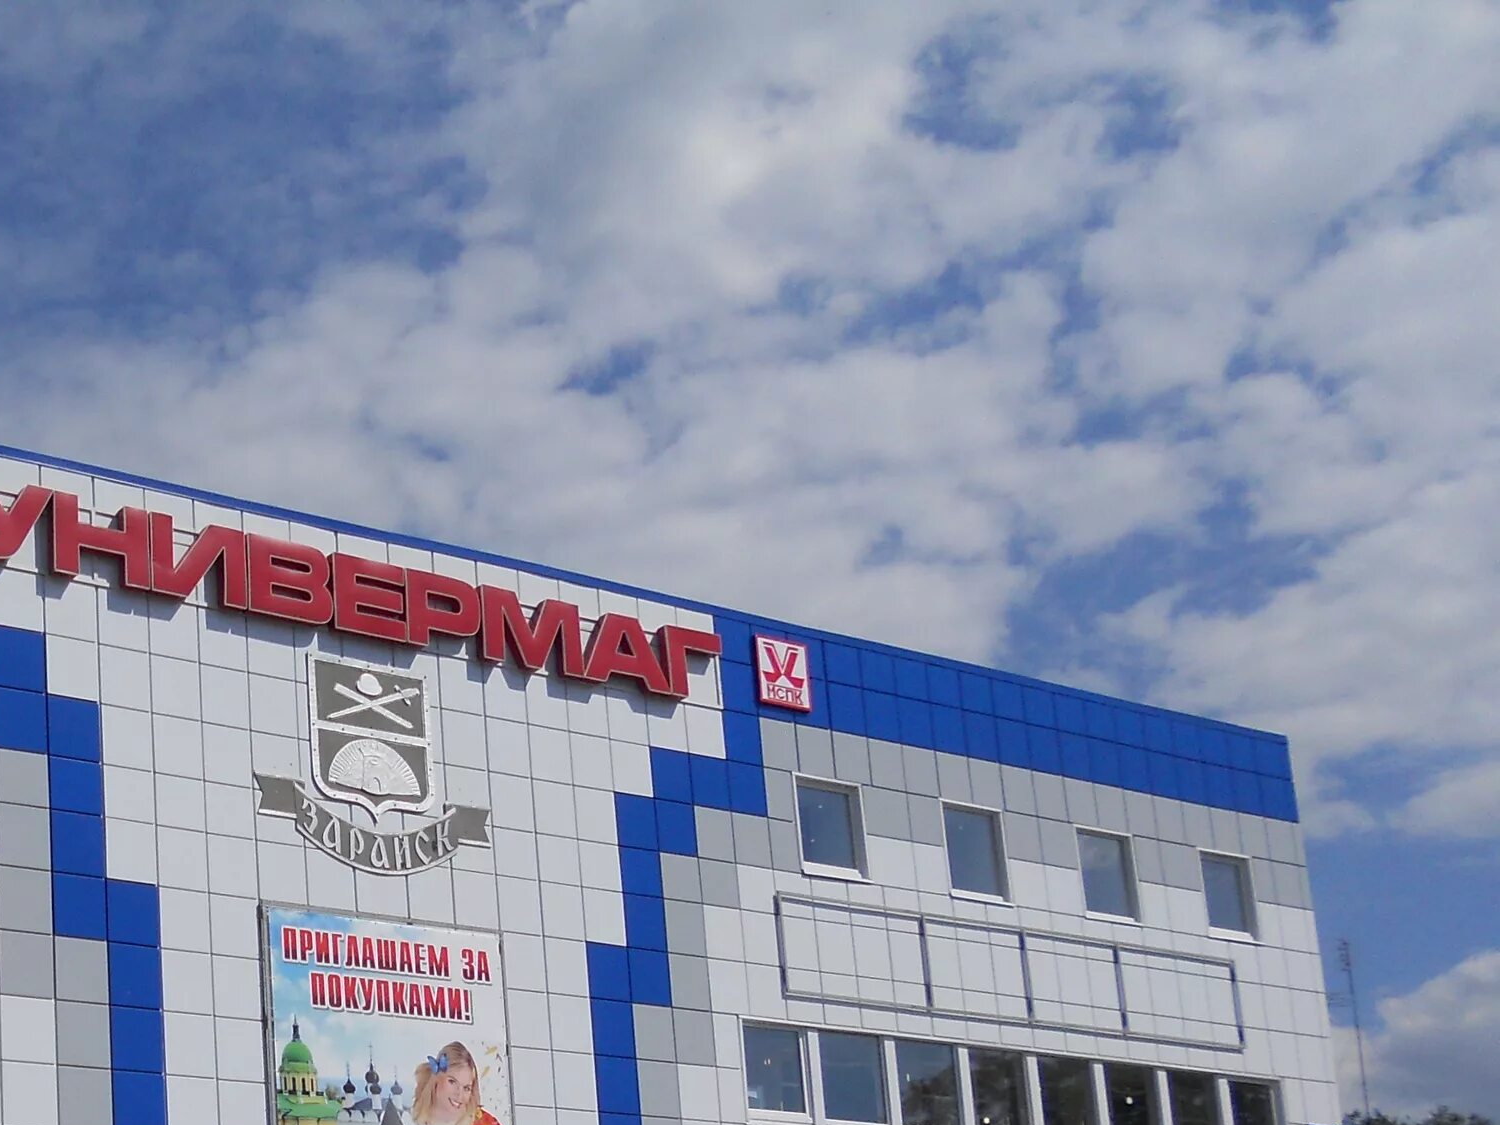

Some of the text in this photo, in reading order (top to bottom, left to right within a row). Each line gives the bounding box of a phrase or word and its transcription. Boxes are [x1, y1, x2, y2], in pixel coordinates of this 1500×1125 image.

[282, 927, 491, 983] ПРИГЛАШАЕМ ЗА
[310, 972, 472, 1021] ПОКУПКАМИ!
